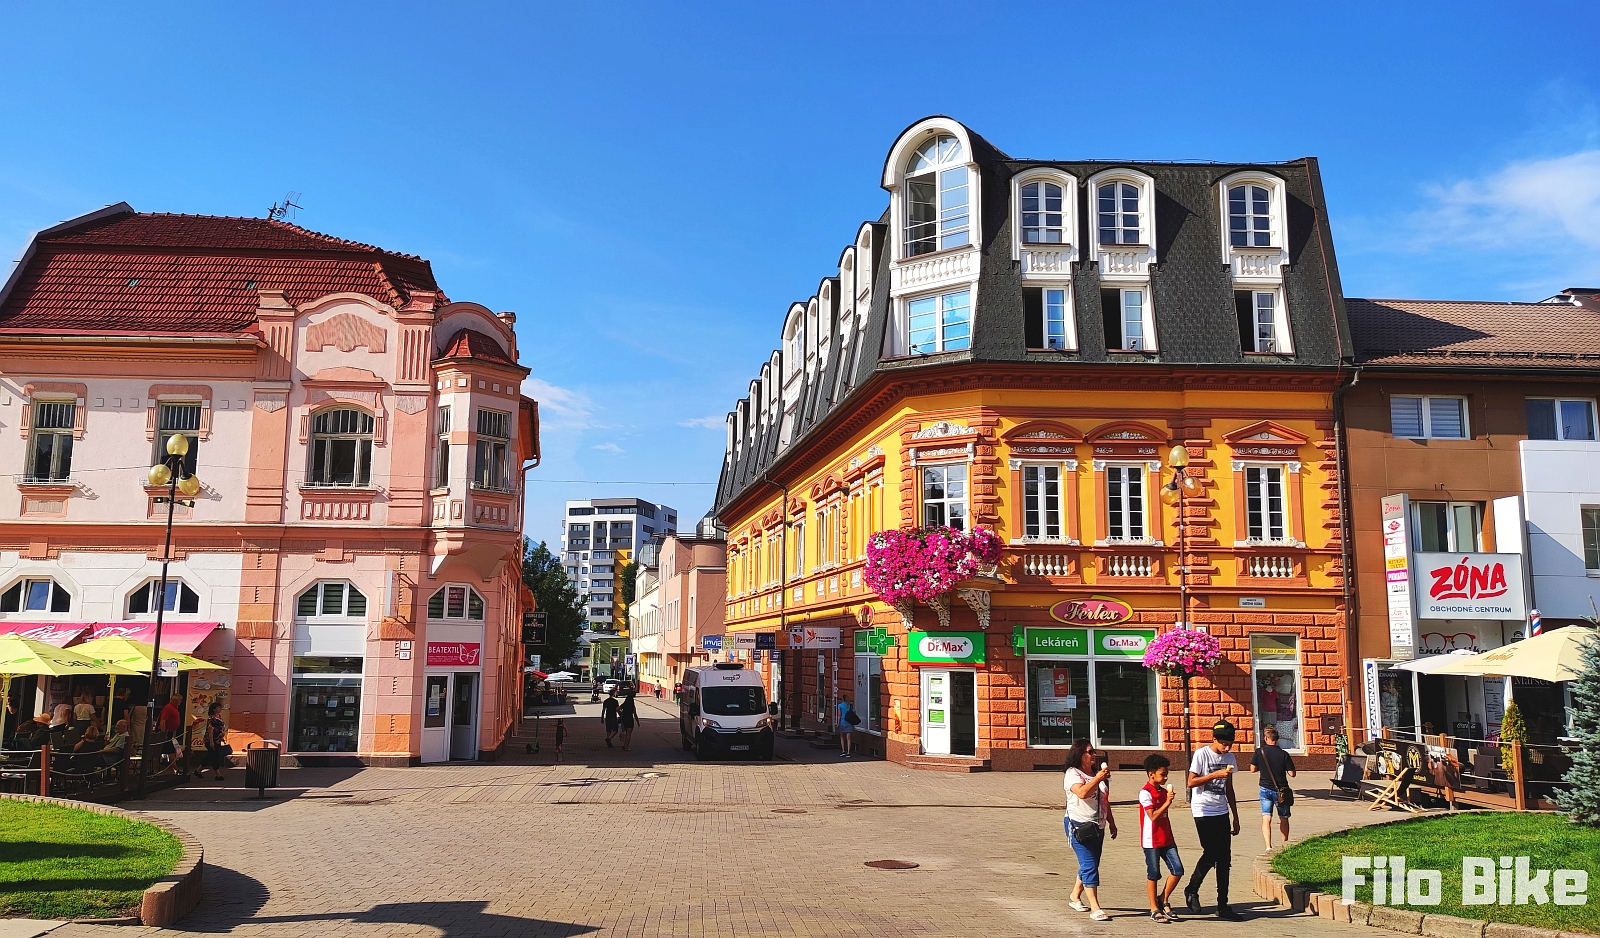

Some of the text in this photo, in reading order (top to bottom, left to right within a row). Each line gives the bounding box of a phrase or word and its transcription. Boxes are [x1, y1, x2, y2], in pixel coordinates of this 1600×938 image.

[1430, 556, 1507, 600] ZÓNA
[1429, 604, 1473, 613] OBCHODNÉ
[704, 638, 722, 647] invia
[1035, 636, 1079, 647] Lekáreň
[1109, 638, 1139, 647] Dr.Max
[428, 646, 460, 654] BEATEXTIL
[927, 641, 964, 652] Dr.Max
